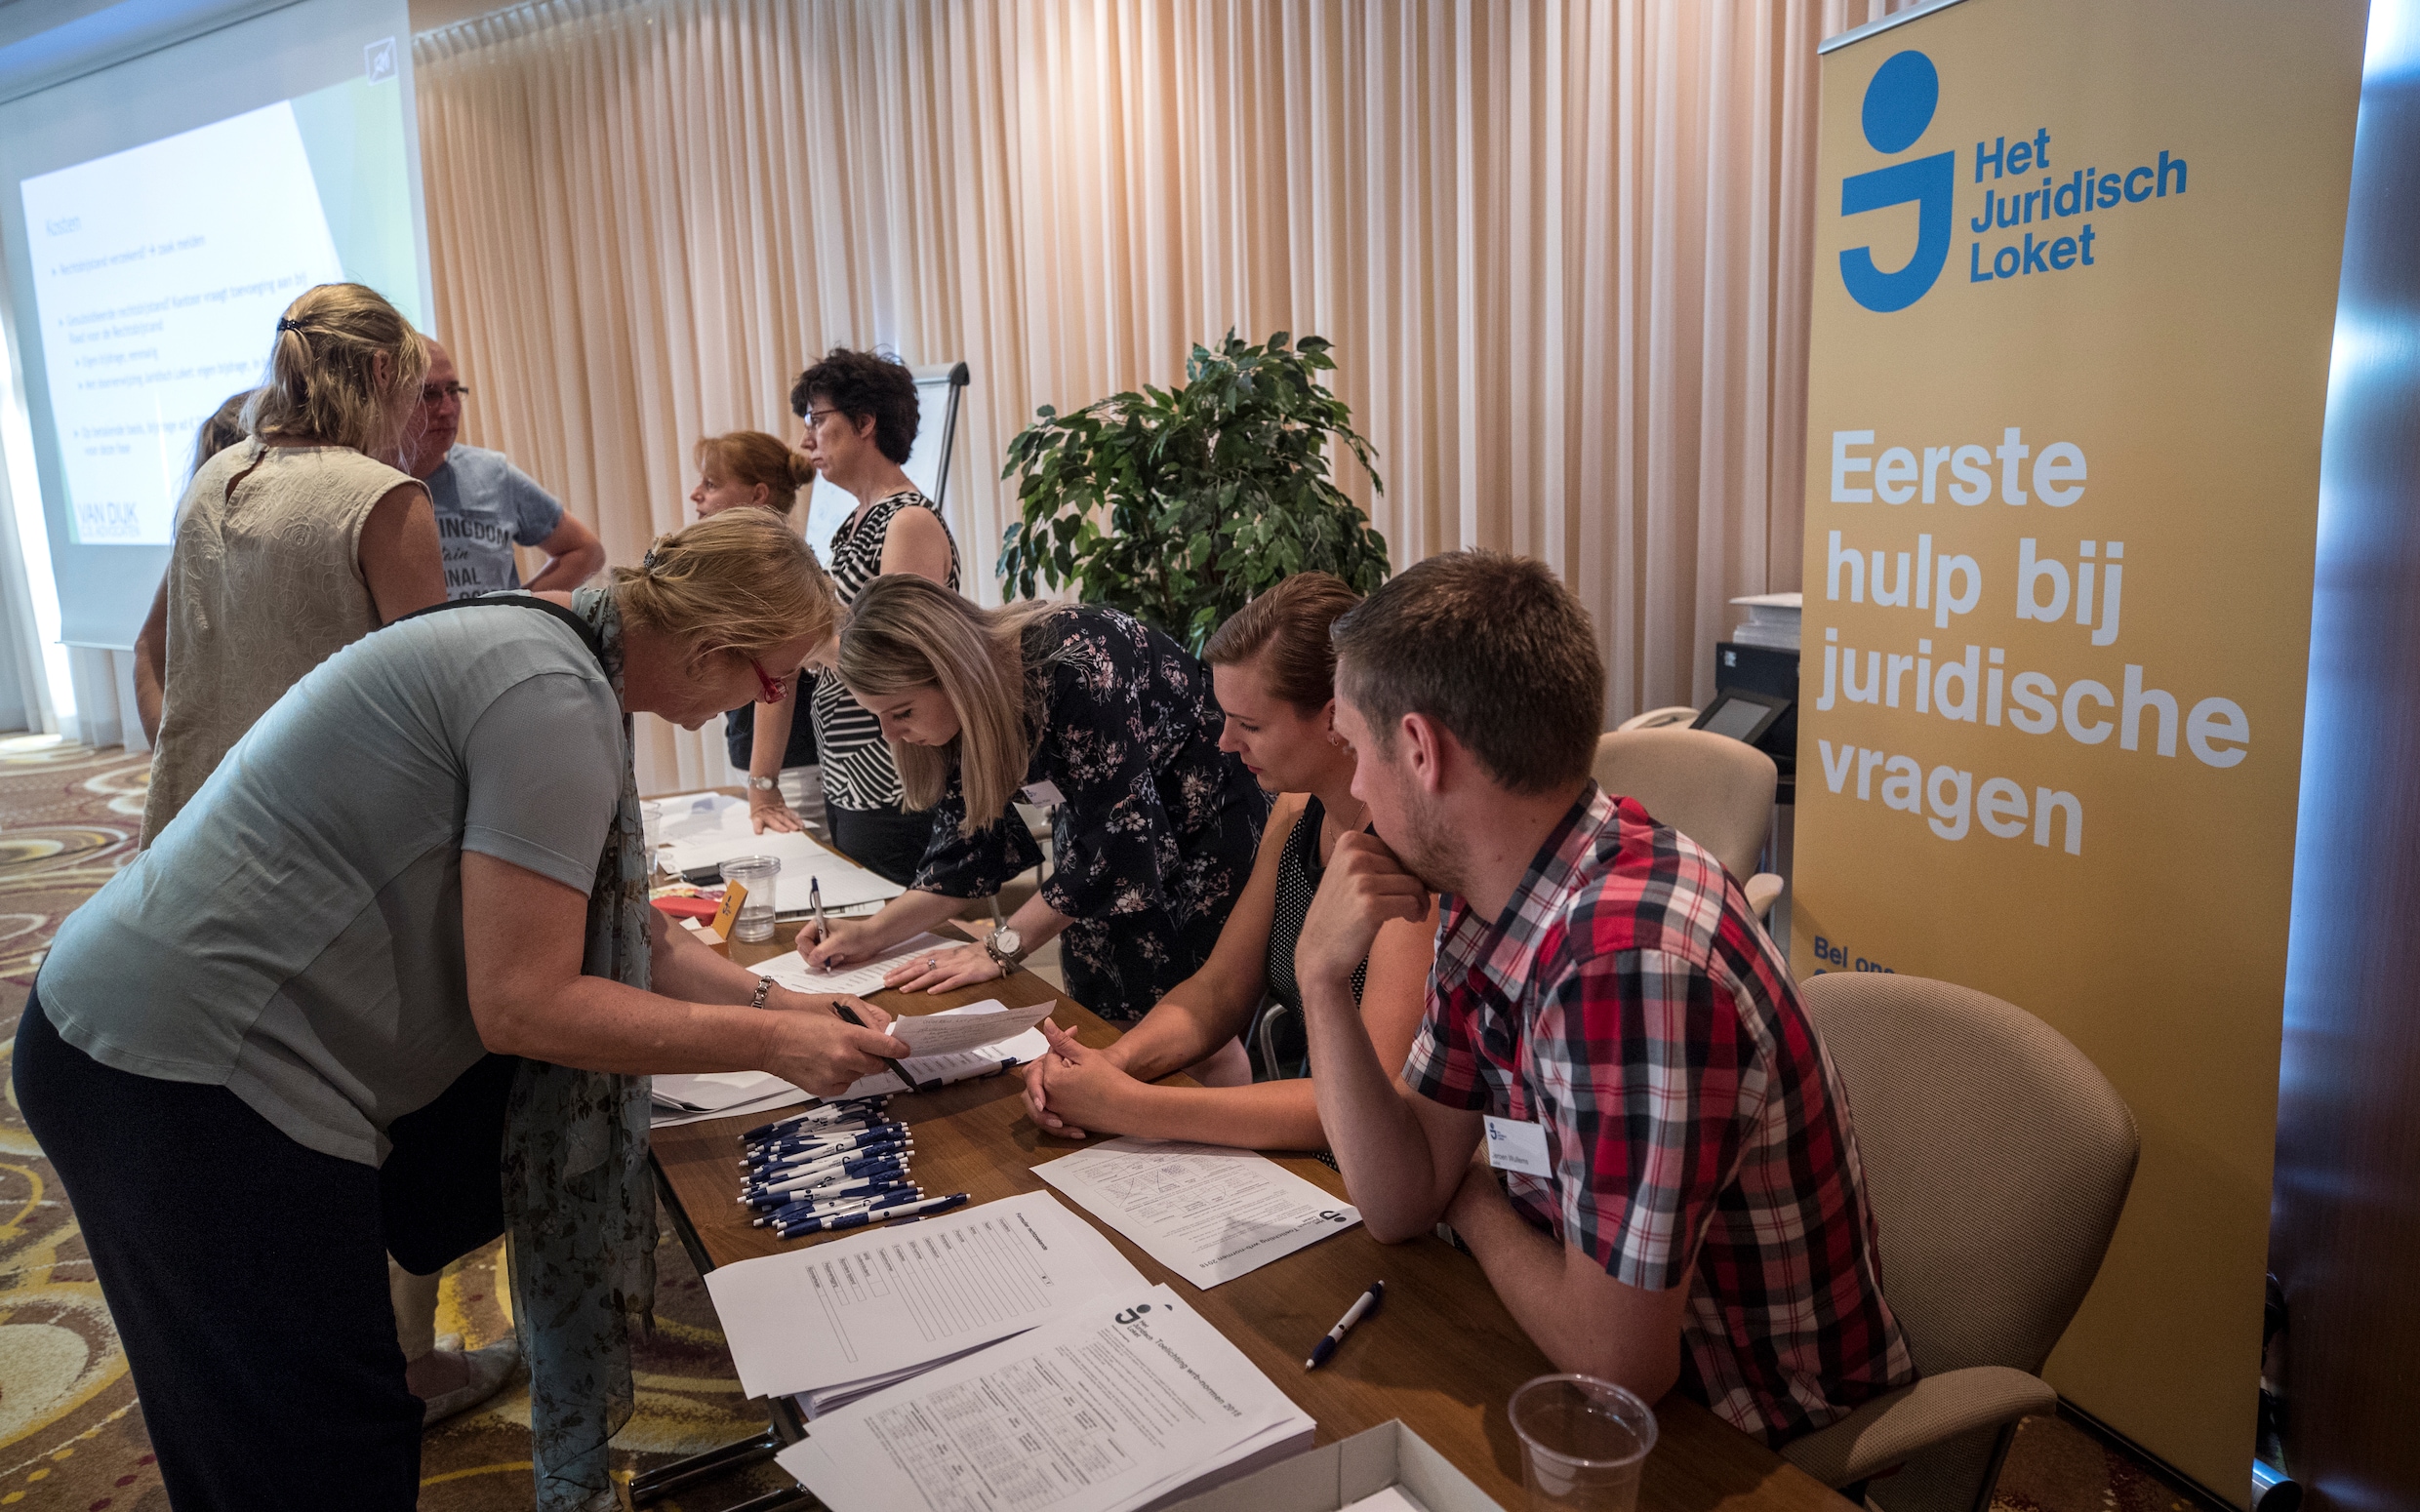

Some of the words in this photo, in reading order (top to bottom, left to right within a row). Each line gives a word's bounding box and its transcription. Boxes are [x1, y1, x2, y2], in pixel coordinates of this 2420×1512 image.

[1971, 128, 2050, 183] Het
[1971, 150, 2187, 233] Juridisch
[1971, 224, 2095, 283] Loket
[1832, 428, 2086, 506] Eerste
[77, 501, 104, 524] VAN
[435, 517, 508, 547] INGDOM
[444, 568, 481, 587] INAL
[1828, 531, 1981, 627] hulp
[2018, 538, 2122, 645] bij
[1818, 628, 2248, 767] juridische
[1818, 740, 2082, 855] vragen
[1814, 935, 1847, 968] Bel
[1217, 1241, 1259, 1260] wrb-normen
[1260, 1227, 1300, 1244] Toelichting
[1198, 1259, 1218, 1269] 2018
[1127, 1326, 1141, 1338] Loket
[1155, 1338, 1188, 1370] Toelichting
[1187, 1368, 1225, 1405] wrb-normen
[1223, 1403, 1242, 1417] 2018
